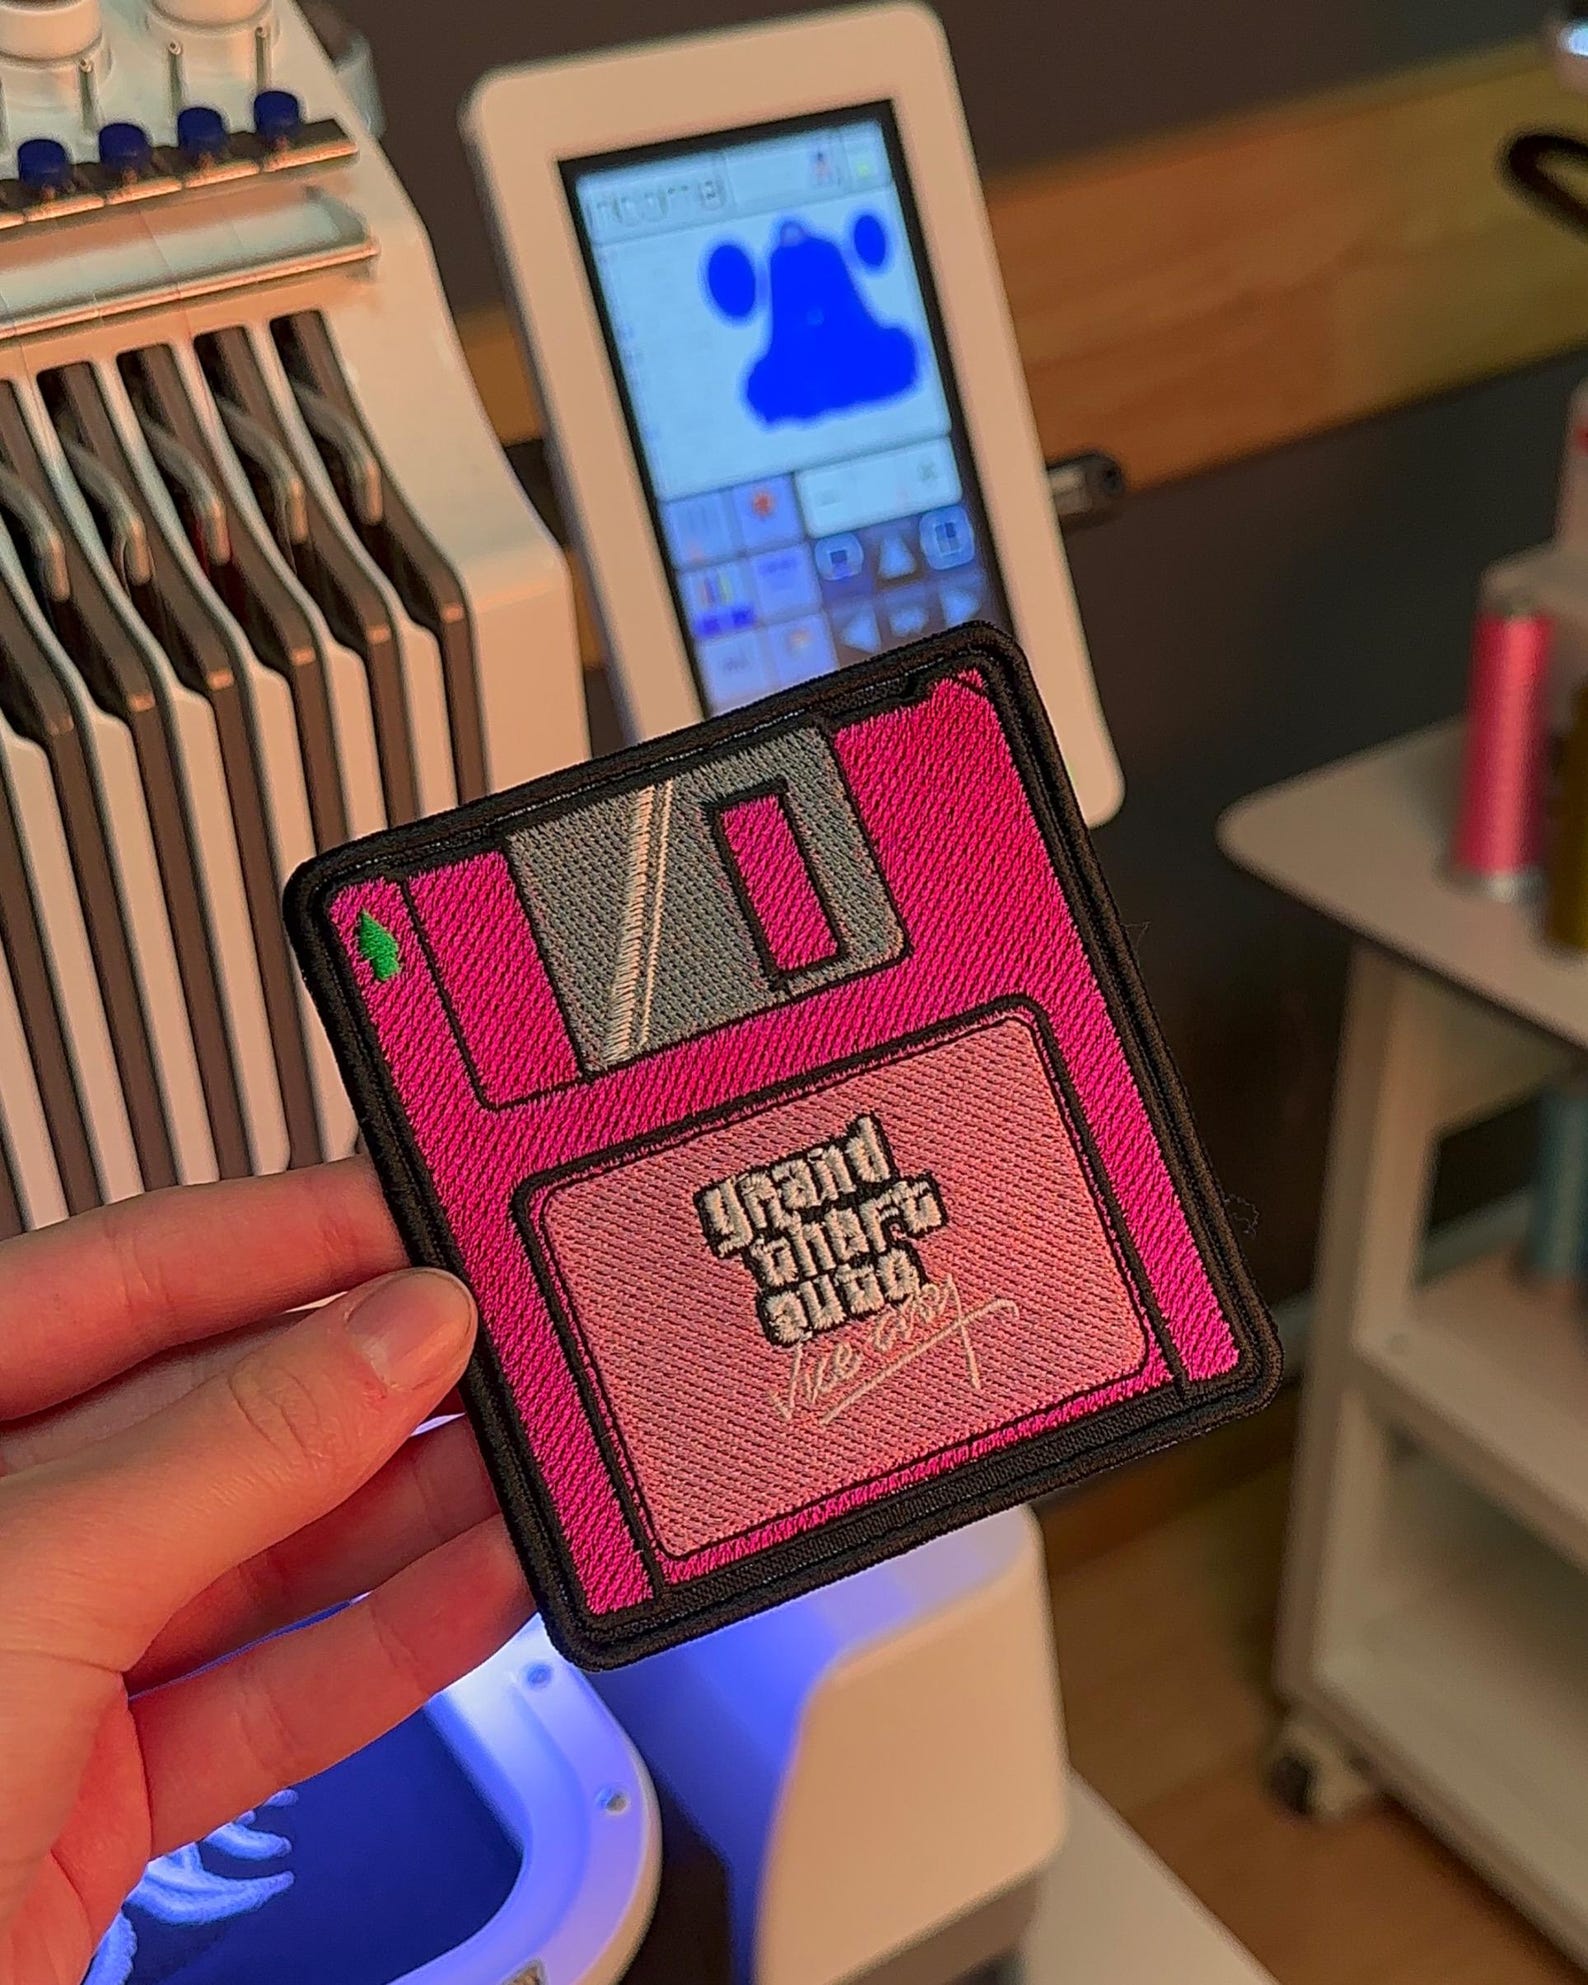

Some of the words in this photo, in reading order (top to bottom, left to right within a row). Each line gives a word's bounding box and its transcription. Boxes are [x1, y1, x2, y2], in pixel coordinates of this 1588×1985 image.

[698, 1114, 893, 1258] grand
[750, 1177, 944, 1287] theft
[764, 1244, 922, 1343] auto
